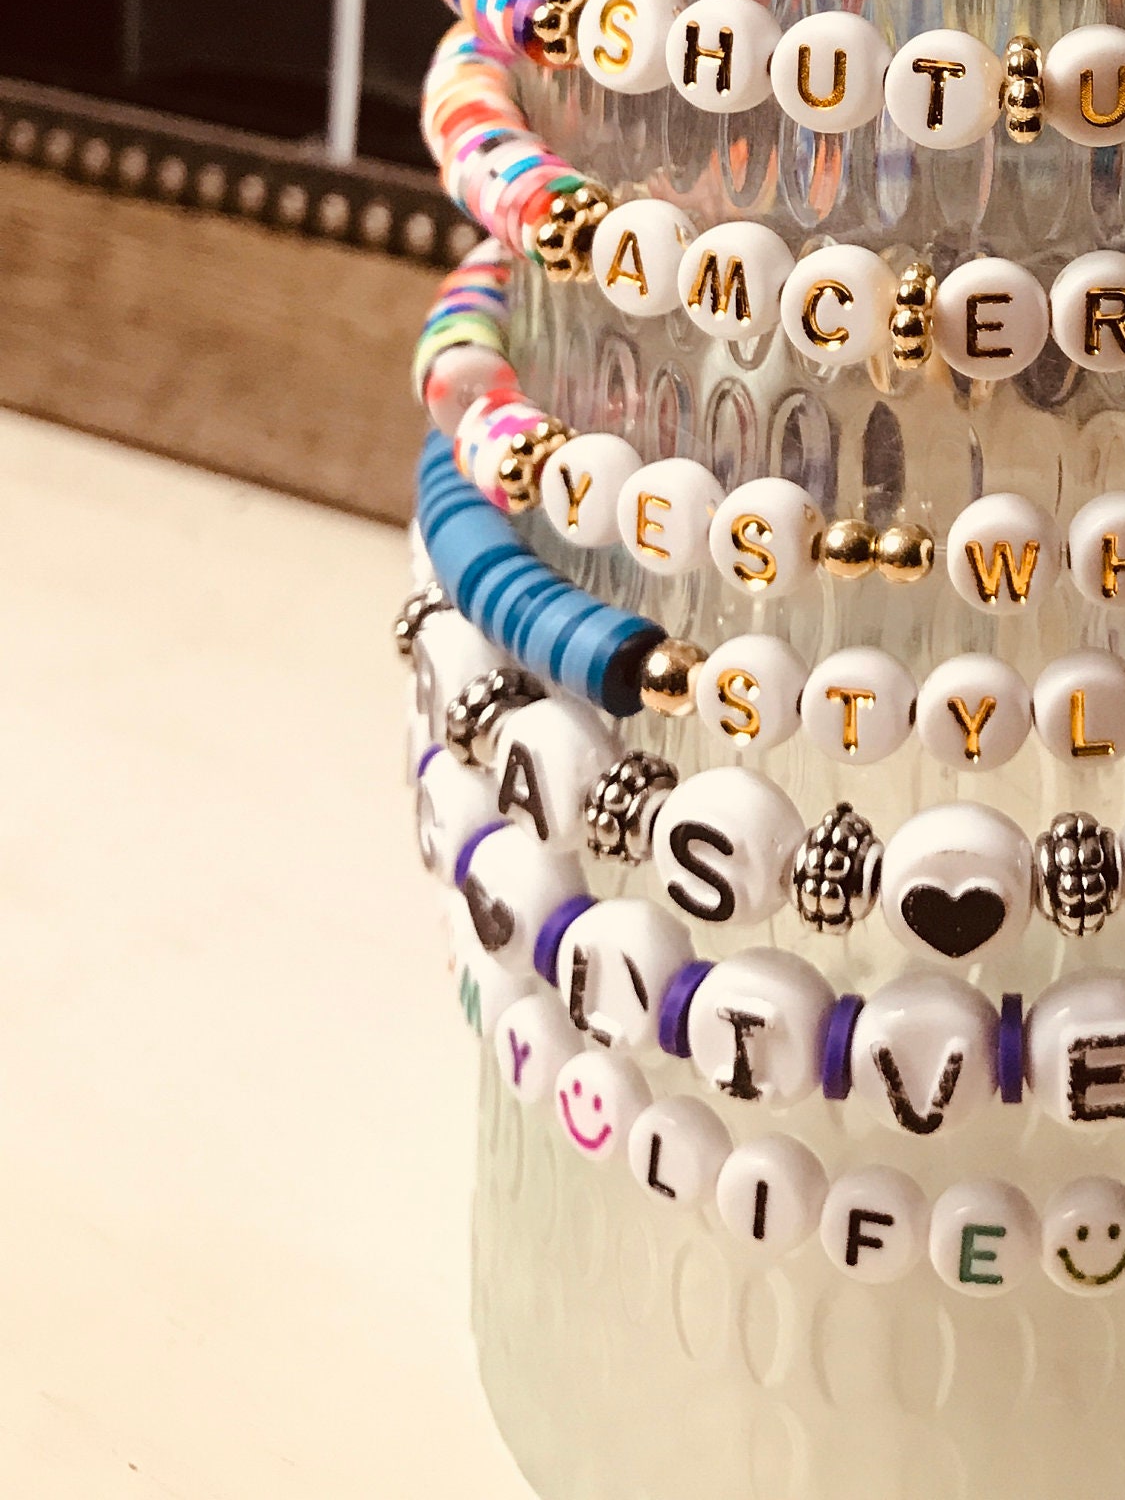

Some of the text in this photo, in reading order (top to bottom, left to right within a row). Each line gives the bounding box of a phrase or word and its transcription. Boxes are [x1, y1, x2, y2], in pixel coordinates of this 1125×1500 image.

[606, 230, 854, 352] AMC
[559, 463, 778, 590] YES
[647, 1133, 1007, 1286] LIFE
